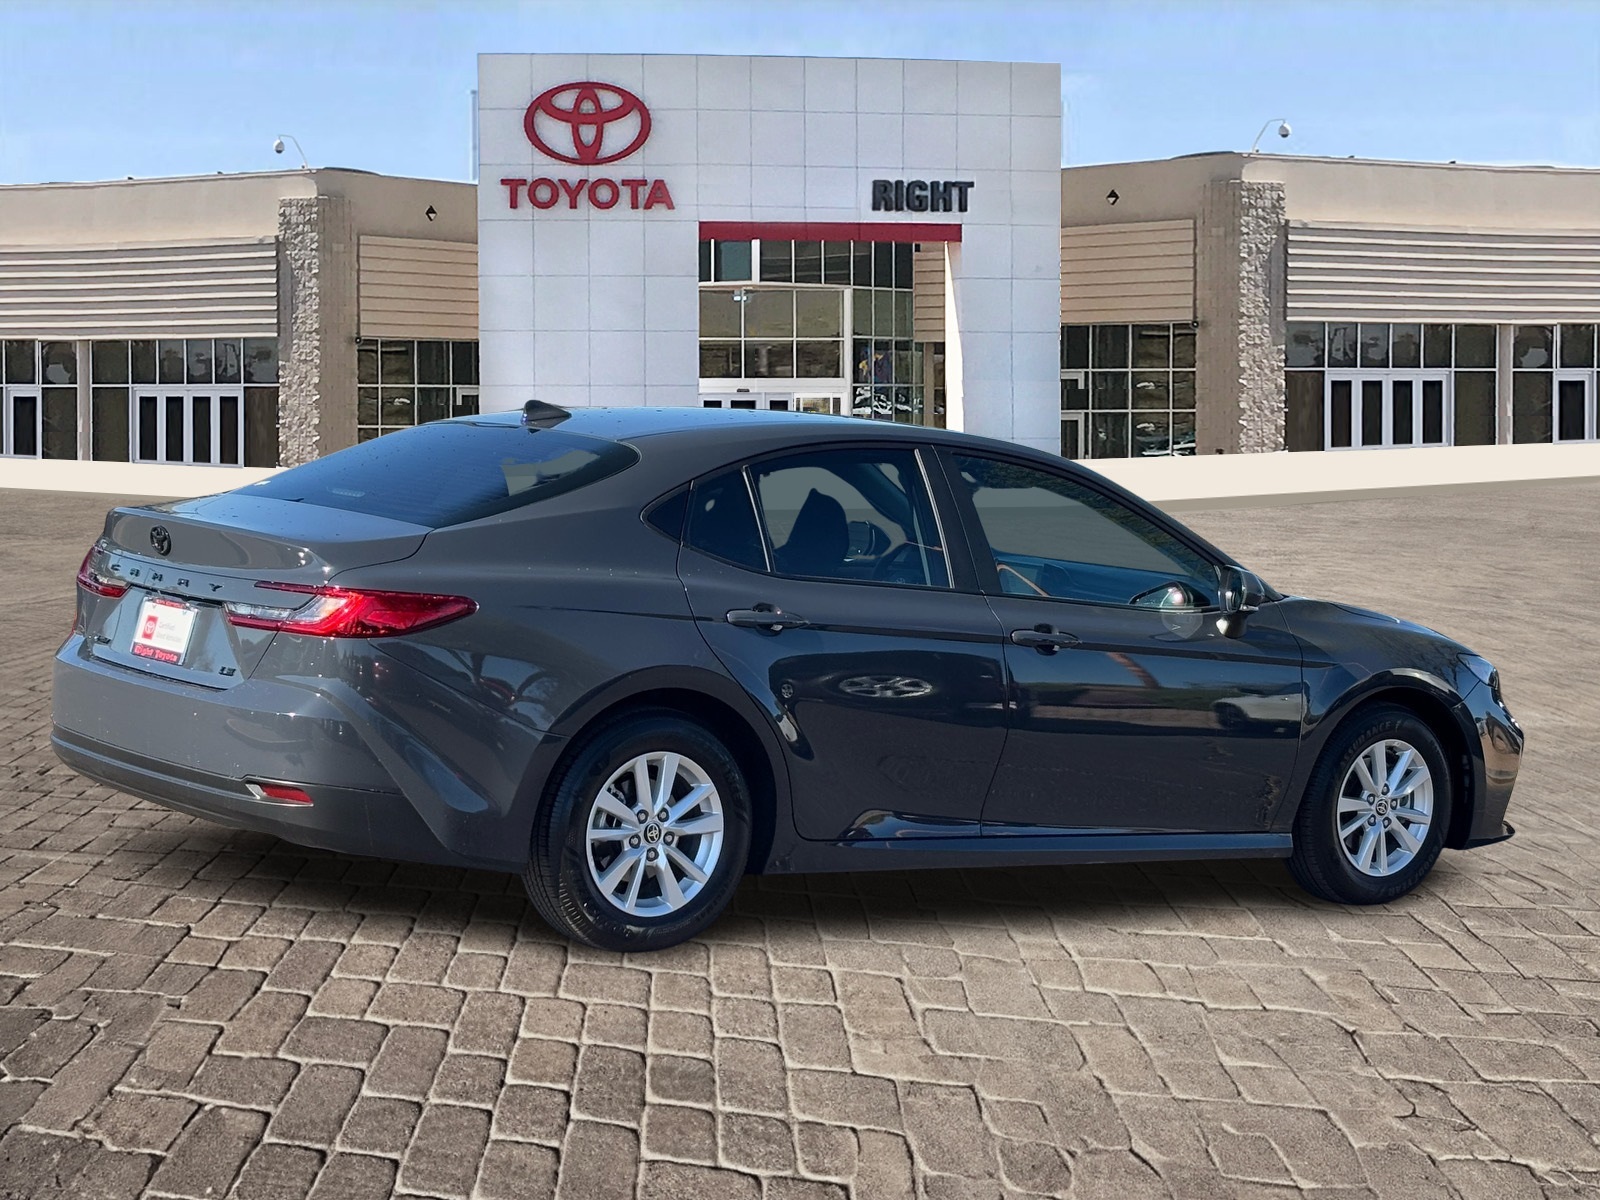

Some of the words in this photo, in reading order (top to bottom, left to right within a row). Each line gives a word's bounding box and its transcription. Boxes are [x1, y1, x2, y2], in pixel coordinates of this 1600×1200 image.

[500, 177, 675, 210] TOYOTA
[872, 179, 975, 213] RIGHT
[110, 563, 223, 592] CAMRY
[154, 649, 178, 662] Toyota
